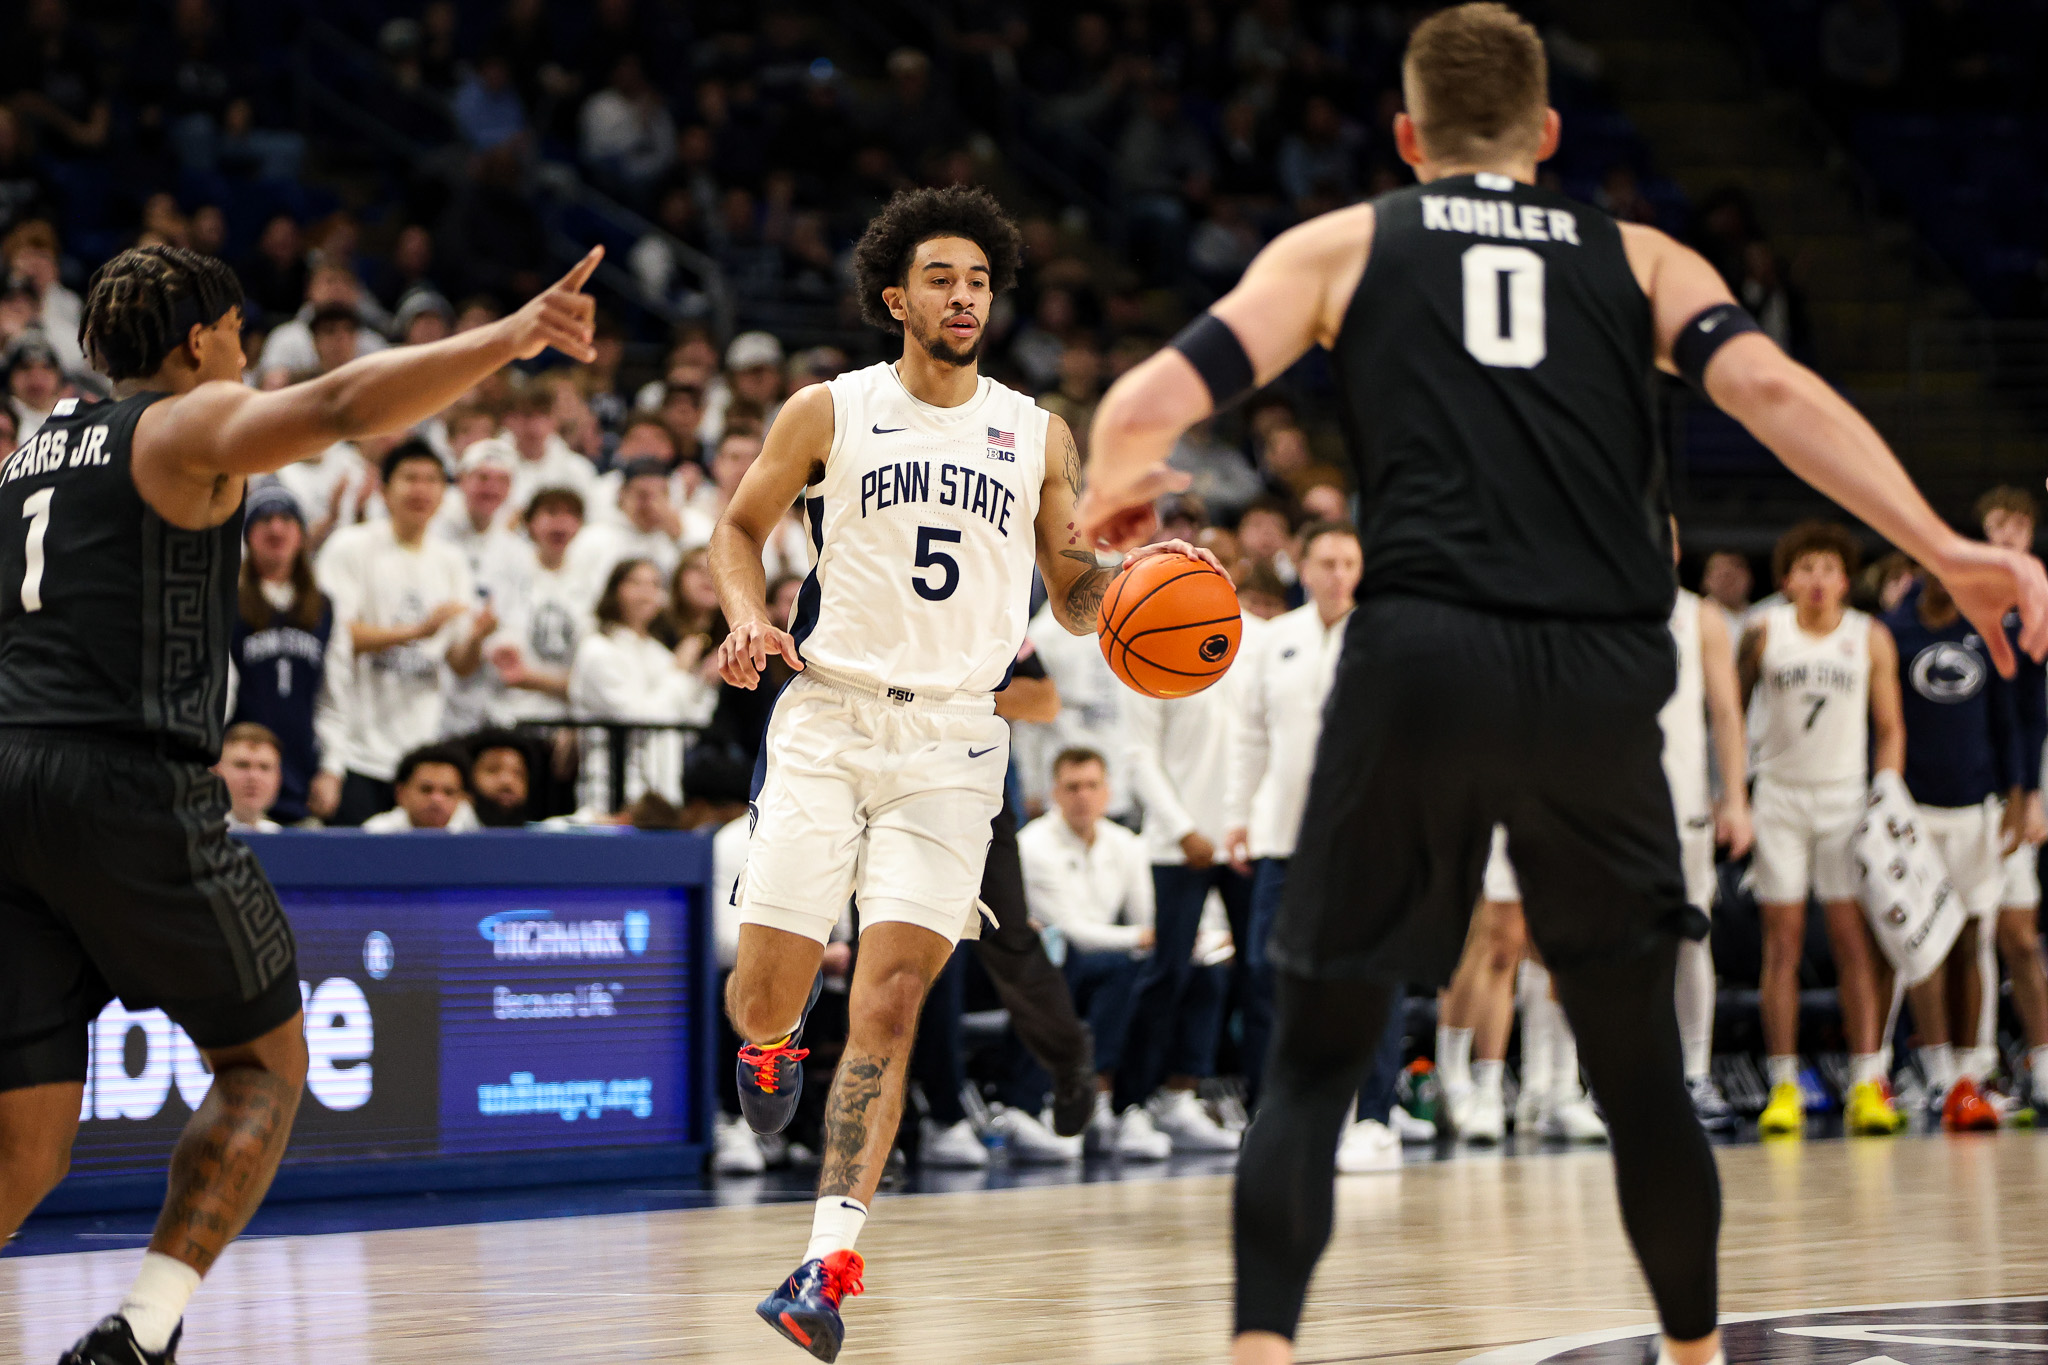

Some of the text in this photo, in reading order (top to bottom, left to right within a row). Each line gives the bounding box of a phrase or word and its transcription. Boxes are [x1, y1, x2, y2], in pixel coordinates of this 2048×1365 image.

[1420, 194, 1582, 246] KOHLER
[1461, 243, 1547, 369] 0
[69, 424, 111, 468] JR.
[861, 461, 1016, 538] PENN STATE
[20, 486, 56, 613] 1
[911, 525, 962, 601] 5
[886, 687, 915, 703] PSU
[1802, 692, 1827, 731] 7
